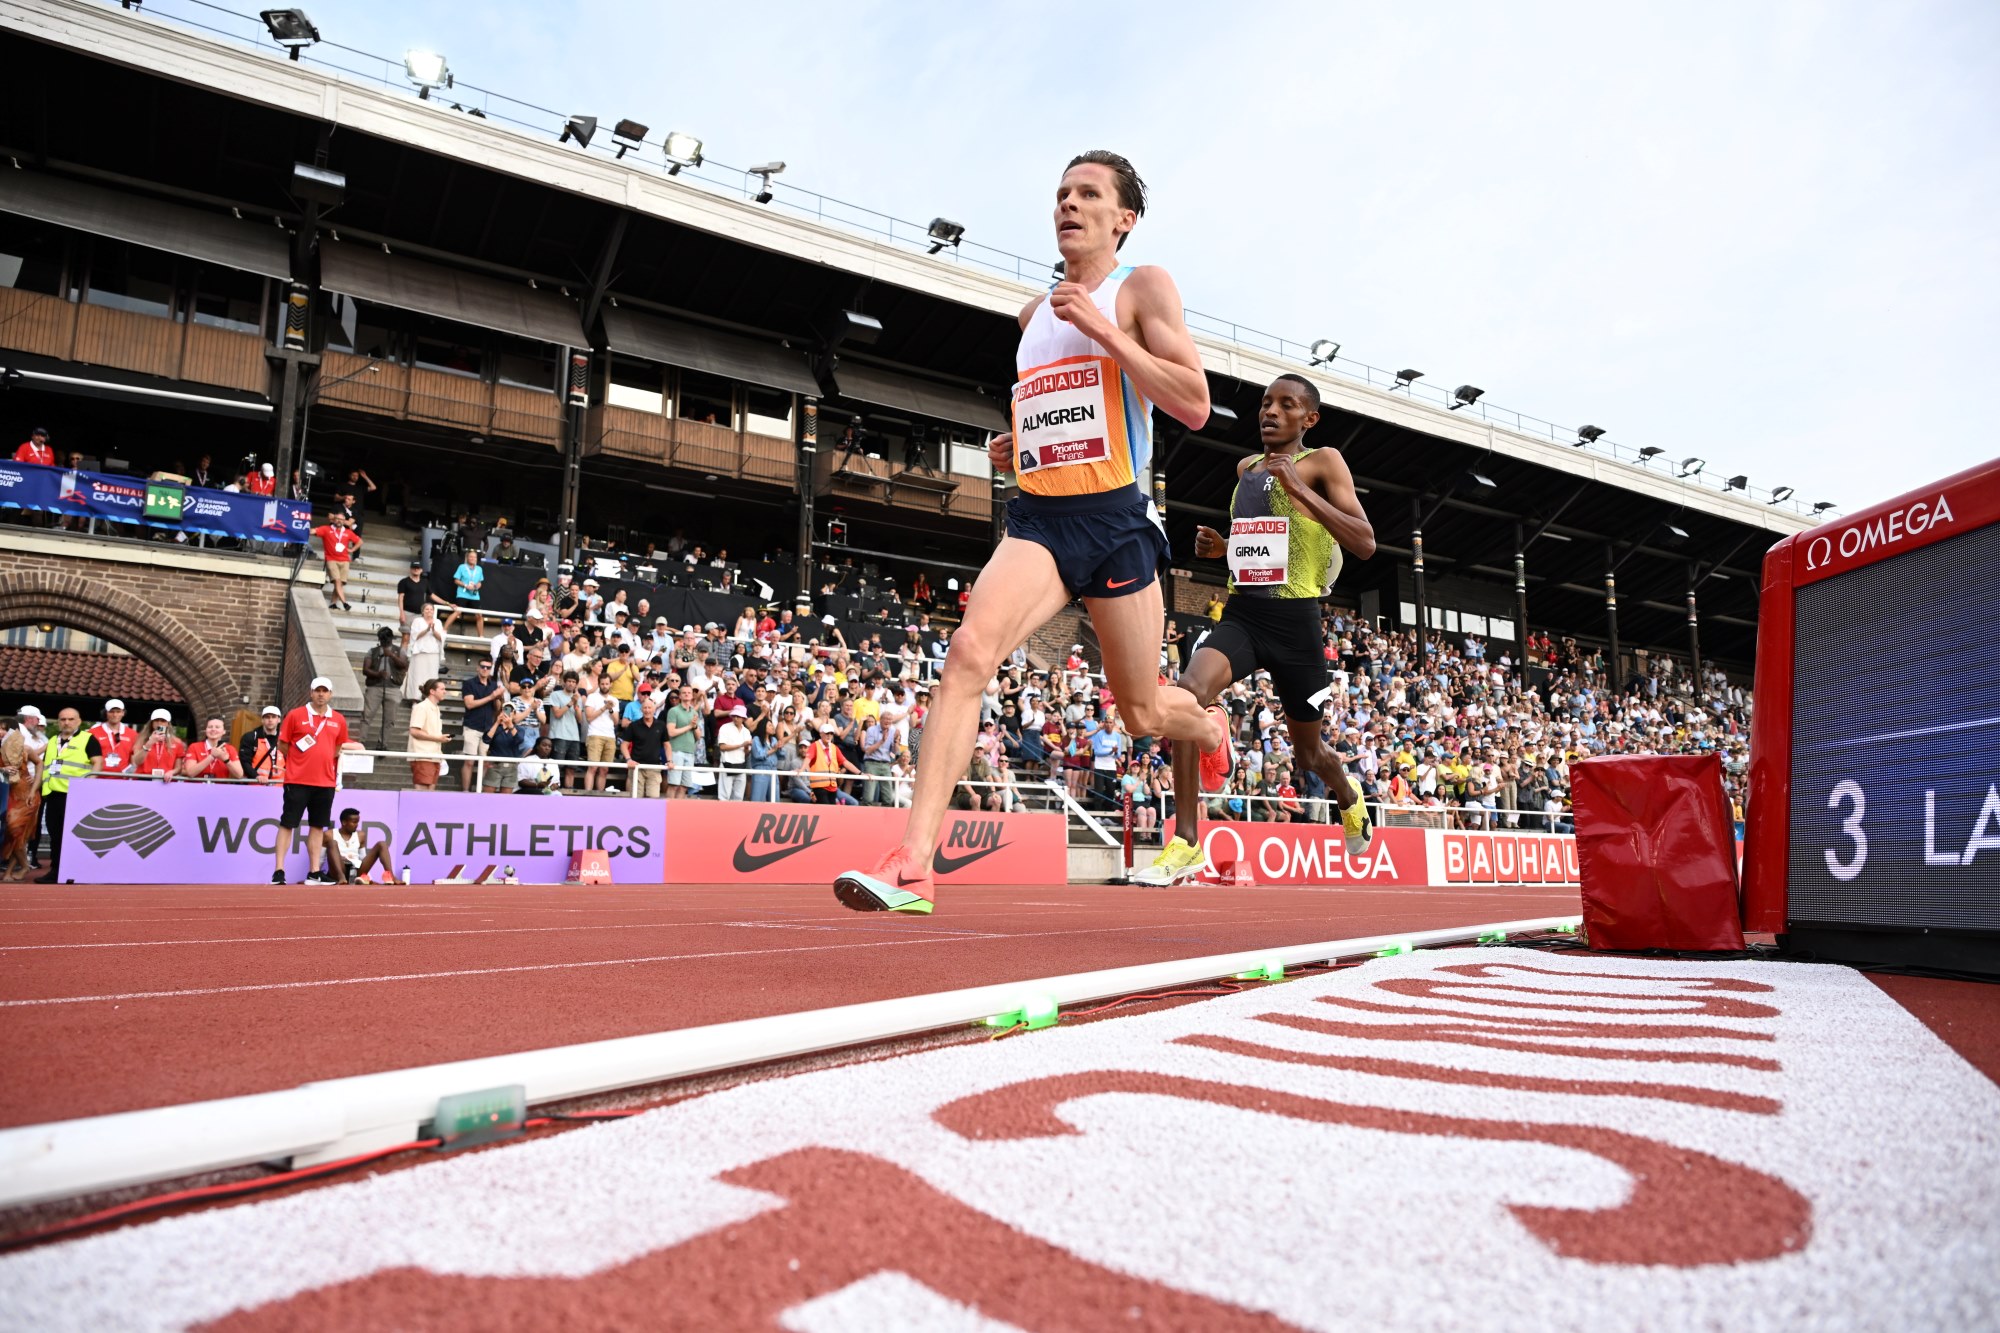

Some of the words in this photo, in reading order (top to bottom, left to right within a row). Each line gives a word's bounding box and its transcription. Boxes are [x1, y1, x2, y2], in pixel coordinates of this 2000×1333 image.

[1019, 369, 1098, 401] BAUHAUS
[1022, 405, 1095, 433] ALMGREN
[1052, 441, 1088, 454] Prioritet
[1056, 451, 1085, 461] Finans
[101, 485, 145, 497] BAUHAU
[194, 508, 223, 517] LEAGUE
[196, 502, 231, 512] DIAMOND
[1231, 521, 1286, 534] BAUHAUS
[1840, 494, 1954, 558] OMEGA
[1235, 546, 1270, 557] GIRMA
[402, 821, 651, 859] ATHLETICS
[751, 813, 820, 845] RUN
[947, 820, 1004, 849] RUN
[1824, 779, 1868, 882] 3
[1258, 837, 1399, 880] OMEGA
[1446, 840, 1581, 877] BAUHAU
[581, 869, 609, 877] OMEGA
